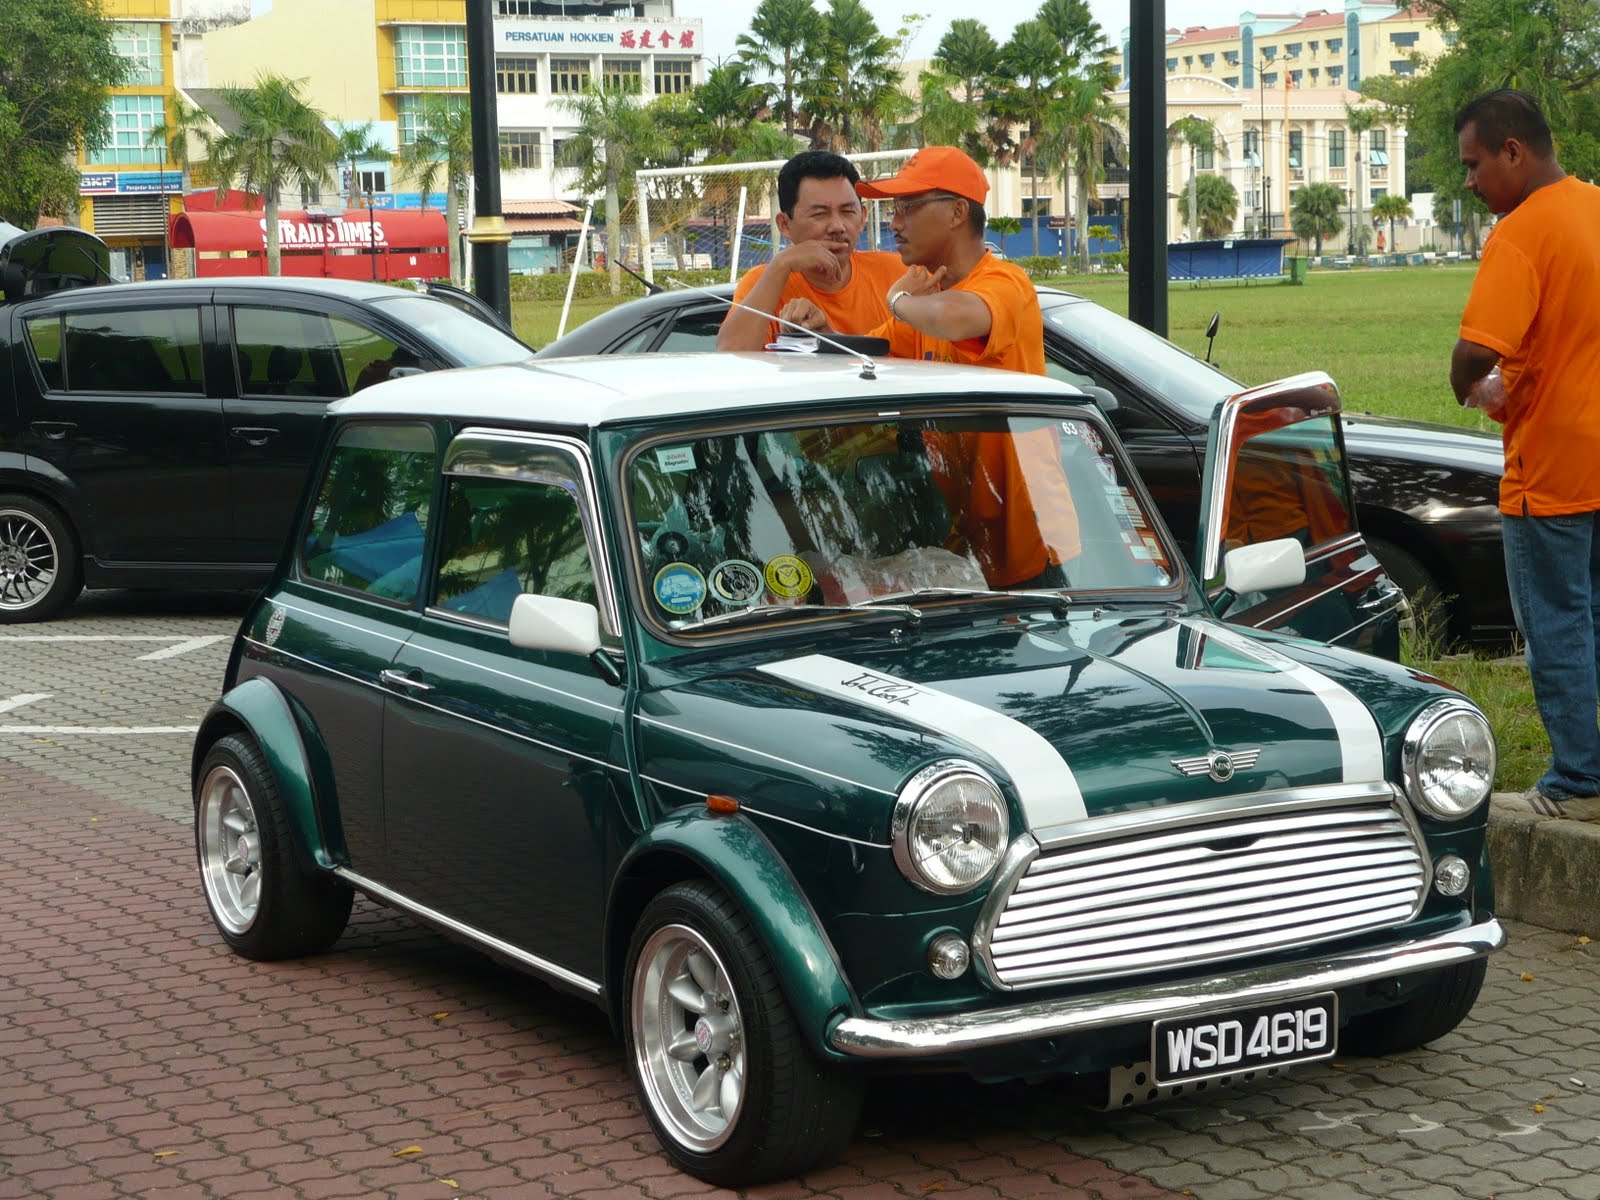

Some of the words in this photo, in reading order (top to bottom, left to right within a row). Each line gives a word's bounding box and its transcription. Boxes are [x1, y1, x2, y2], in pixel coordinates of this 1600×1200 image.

[505, 31, 564, 42] PERSATUAN
[570, 32, 614, 42] HOKKIEN
[332, 217, 385, 242] TIMES
[1061, 421, 1078, 435] 63
[1167, 1020, 1243, 1074] WSD
[1246, 1006, 1328, 1058] 4619
